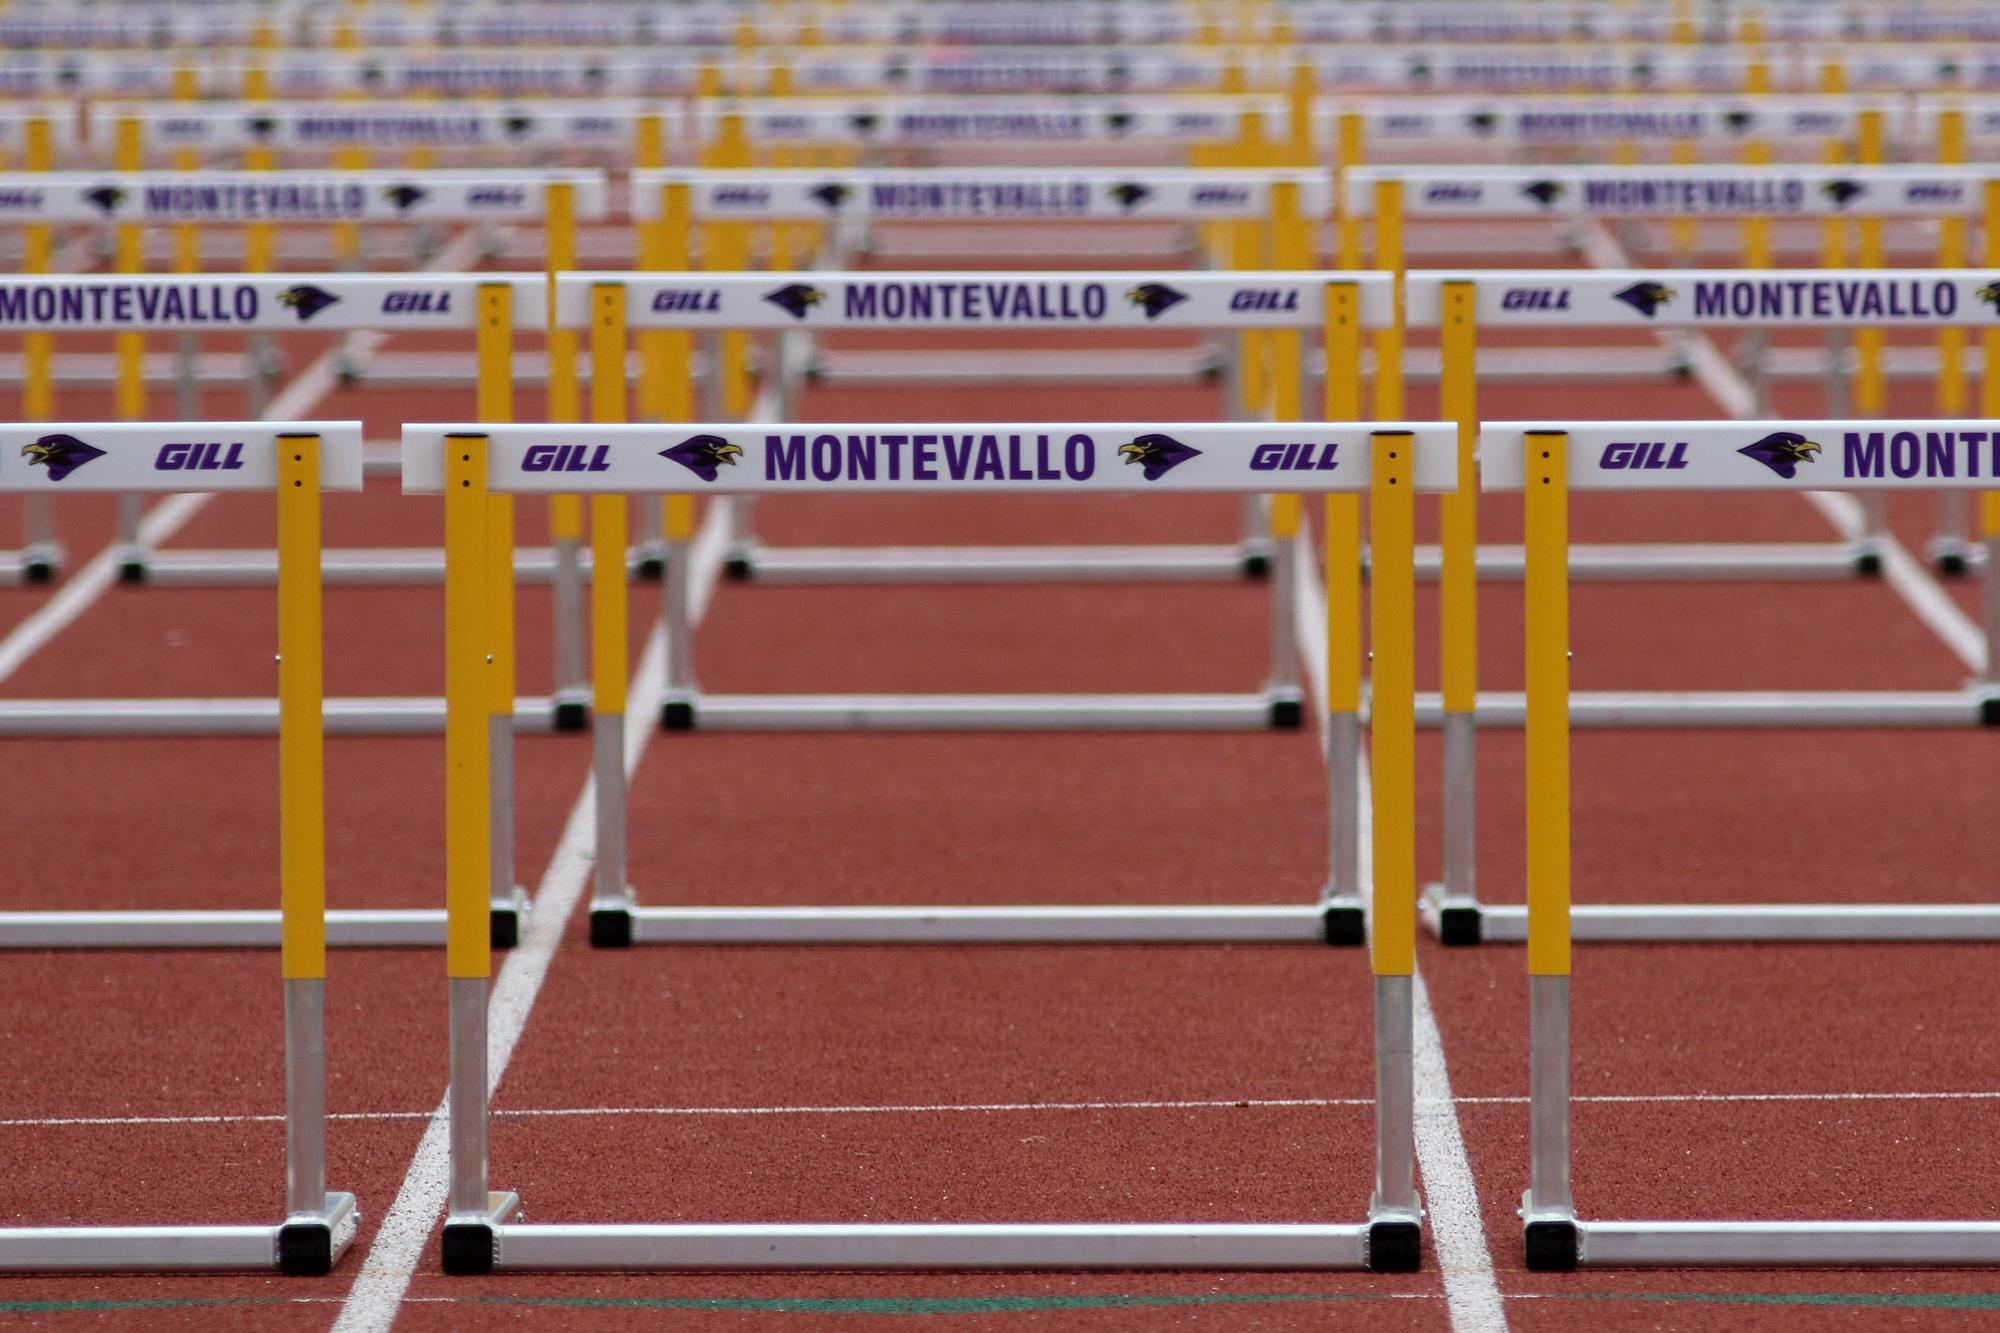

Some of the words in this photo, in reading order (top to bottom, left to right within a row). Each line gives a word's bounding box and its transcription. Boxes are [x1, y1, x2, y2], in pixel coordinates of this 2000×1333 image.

[144, 185, 365, 216] MONTEVALLO
[873, 184, 1090, 214] MONTEVALLO
[1584, 181, 1803, 211] MONTEVALLO
[0, 284, 258, 322] MONTEVALLO
[382, 291, 451, 313] GILL
[652, 290, 720, 312] GILL
[846, 283, 1104, 321] MONTEVALLO
[1229, 289, 1298, 311] GILL
[1501, 288, 1570, 310] GILL
[1694, 280, 1957, 318] MONTEVALLO
[155, 443, 244, 471] GILL
[521, 444, 610, 472] GILL
[765, 433, 1096, 482] MONTEVALLO
[1249, 443, 1338, 471] GILL
[1599, 442, 1688, 470] GILL
